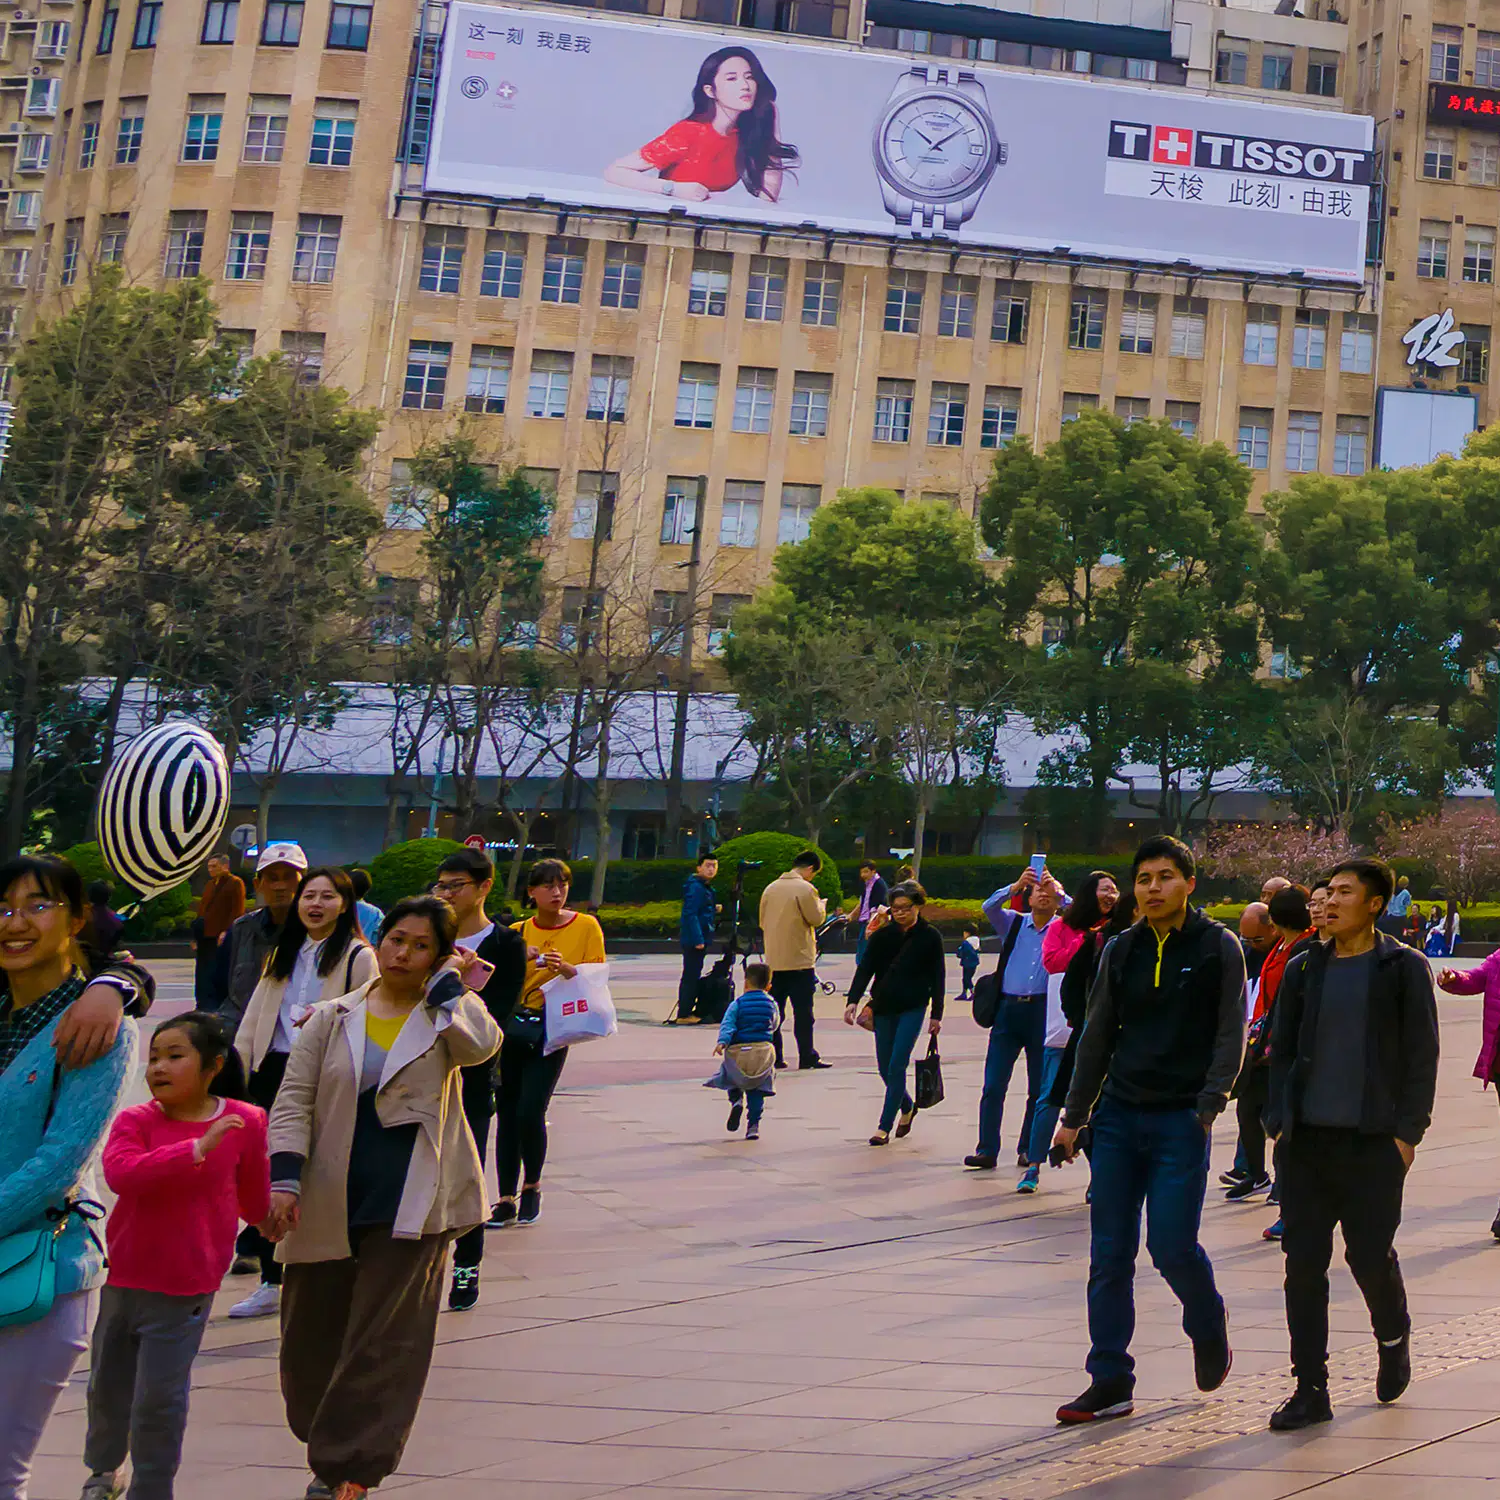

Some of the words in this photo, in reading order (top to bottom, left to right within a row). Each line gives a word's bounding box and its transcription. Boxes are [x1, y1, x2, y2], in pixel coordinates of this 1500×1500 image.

[468, 22, 524, 46] 这一刻
[537, 31, 592, 54] 我是我
[1114, 125, 1148, 156] T
[1202, 135, 1365, 181] TISSOT
[1150, 170, 1204, 201] 天梭
[1228, 178, 1352, 218] 此刻·由我
